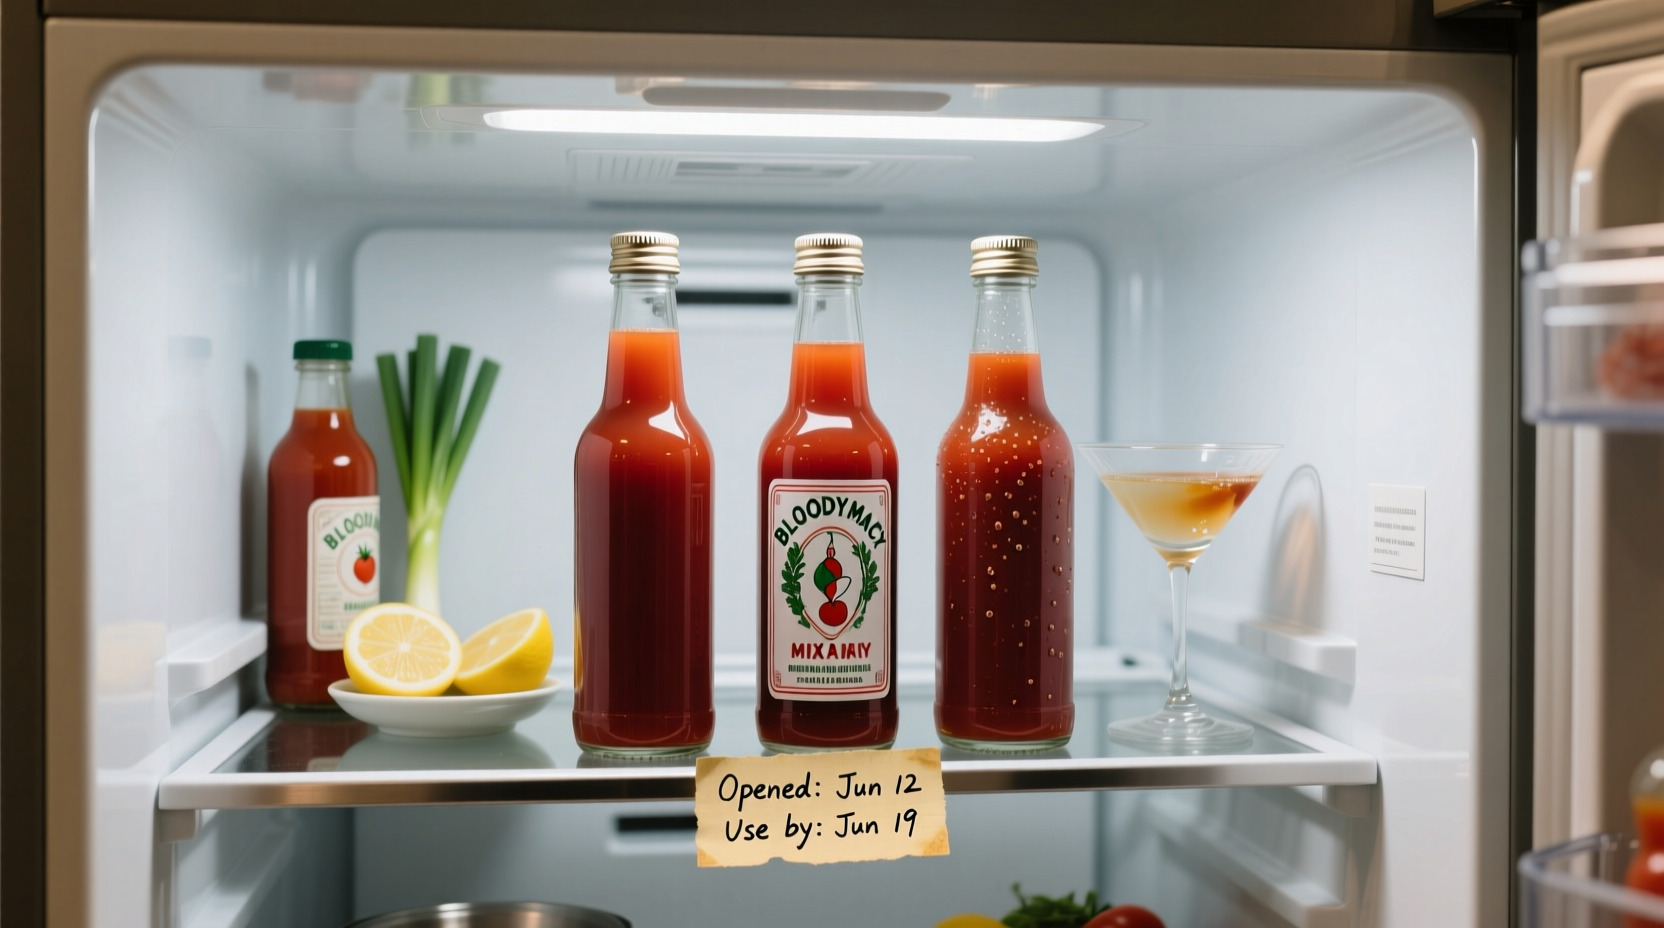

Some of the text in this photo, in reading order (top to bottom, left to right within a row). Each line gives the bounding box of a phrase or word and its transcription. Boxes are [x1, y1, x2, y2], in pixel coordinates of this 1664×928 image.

[718, 771, 922, 812] Opened: Jun 12
[725, 808, 918, 850] Use by: Jun 19
